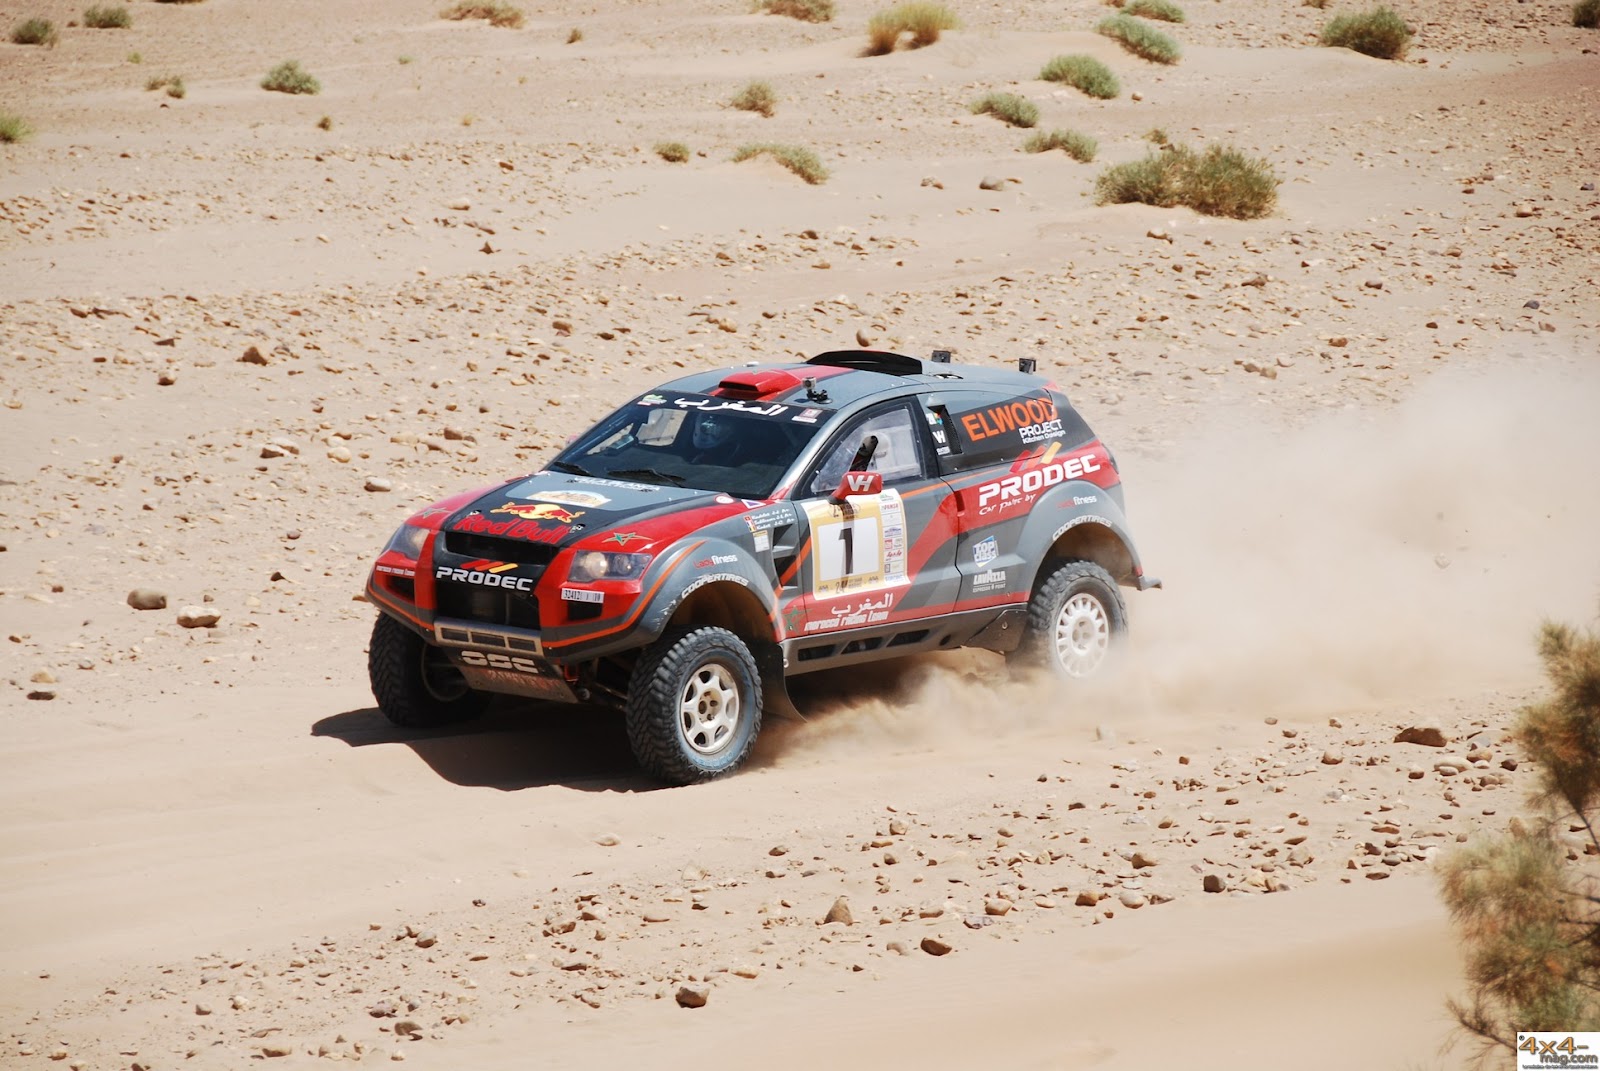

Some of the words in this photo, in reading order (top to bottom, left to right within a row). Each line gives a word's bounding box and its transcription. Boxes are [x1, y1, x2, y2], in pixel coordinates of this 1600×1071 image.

[961, 397, 1058, 442] ELWOOD
[1018, 418, 1063, 439] PROJECT
[846, 474, 875, 492] VH
[978, 453, 1101, 507] PRODEC
[978, 503, 997, 516] Car
[1024, 493, 1037, 504] by
[453, 514, 514, 534] Red
[510, 519, 572, 545] Bull
[838, 527, 854, 575] 1
[435, 566, 534, 592] PRODEC
[973, 569, 1006, 585] LAVAZZA
[831, 593, 893, 618] المغرب
